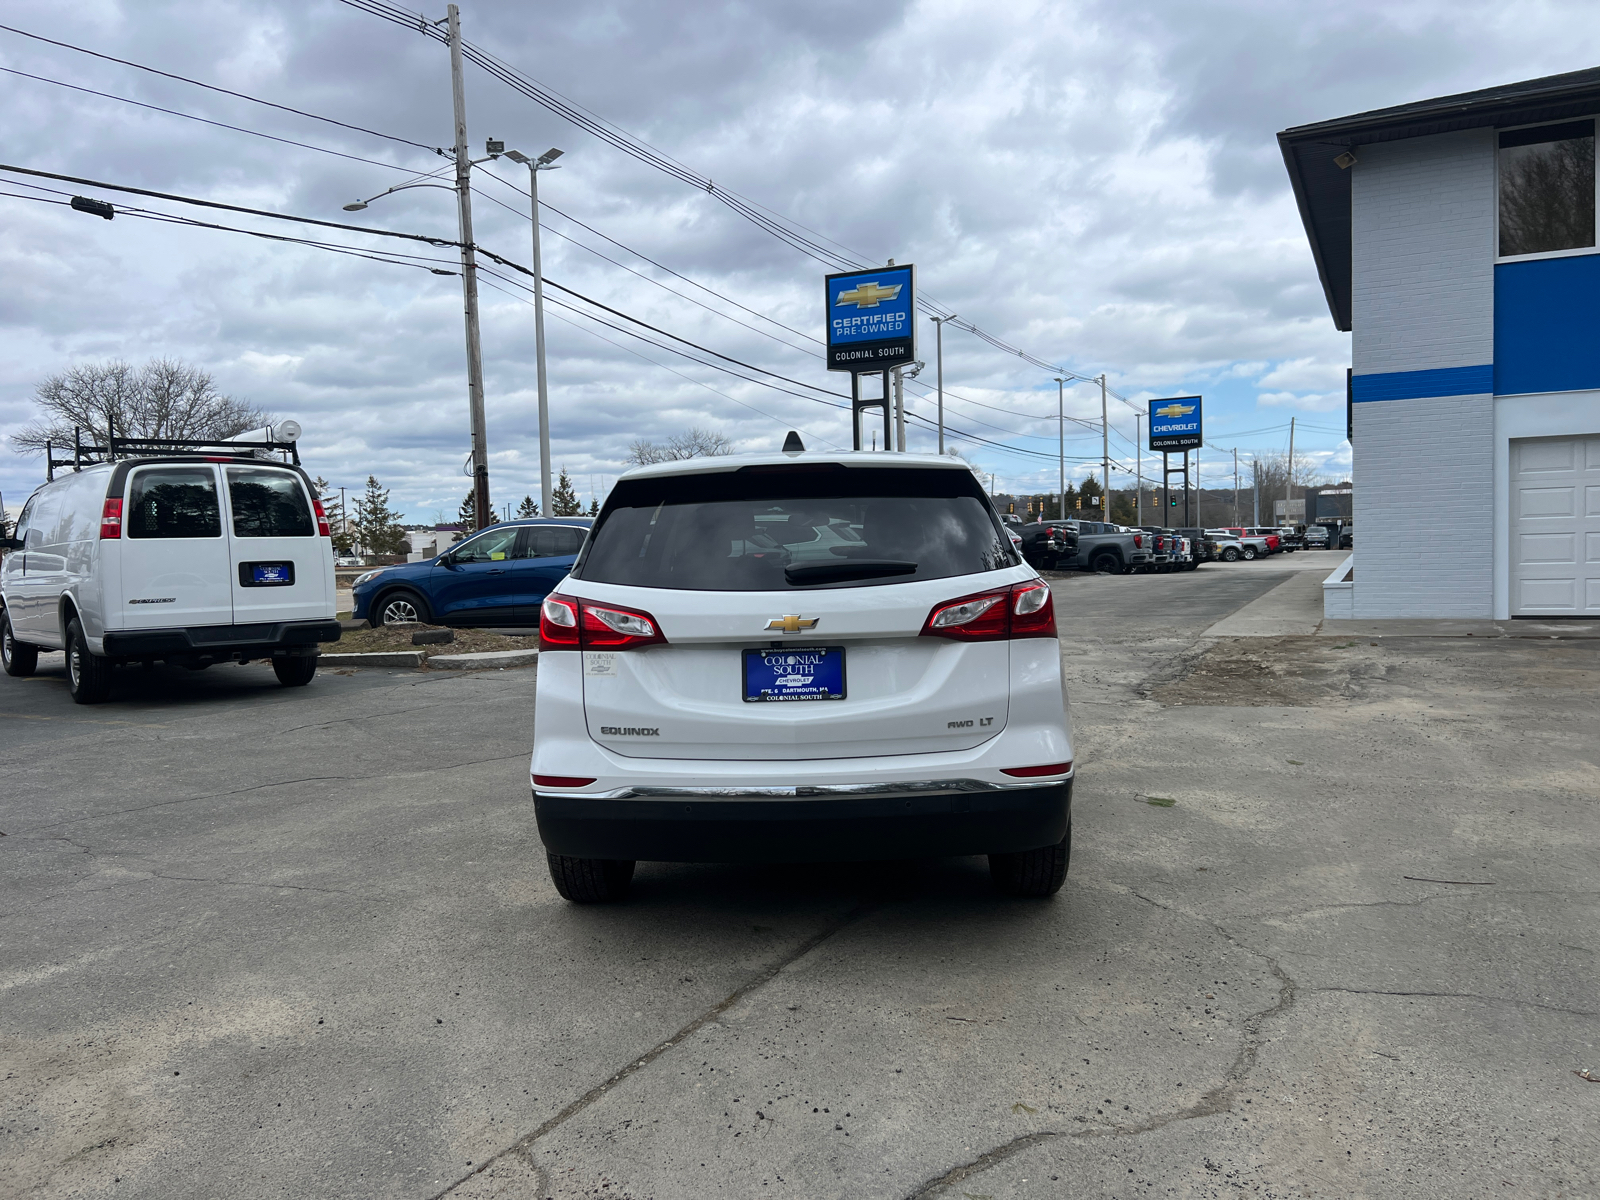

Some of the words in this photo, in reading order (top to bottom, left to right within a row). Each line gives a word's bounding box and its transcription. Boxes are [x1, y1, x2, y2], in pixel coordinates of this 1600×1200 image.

[833, 312, 906, 328] CERTIFIED
[837, 322, 902, 336] PRE-OWNED
[835, 350, 874, 361] COLONIAL
[878, 347, 904, 357] SOUTH
[1153, 422, 1198, 433] CHEVROLET
[764, 654, 823, 666] COLONIAL
[773, 664, 814, 675] SOUTH
[947, 719, 974, 729] AWD
[979, 716, 994, 727] LT
[600, 726, 660, 736] EQUINOX
